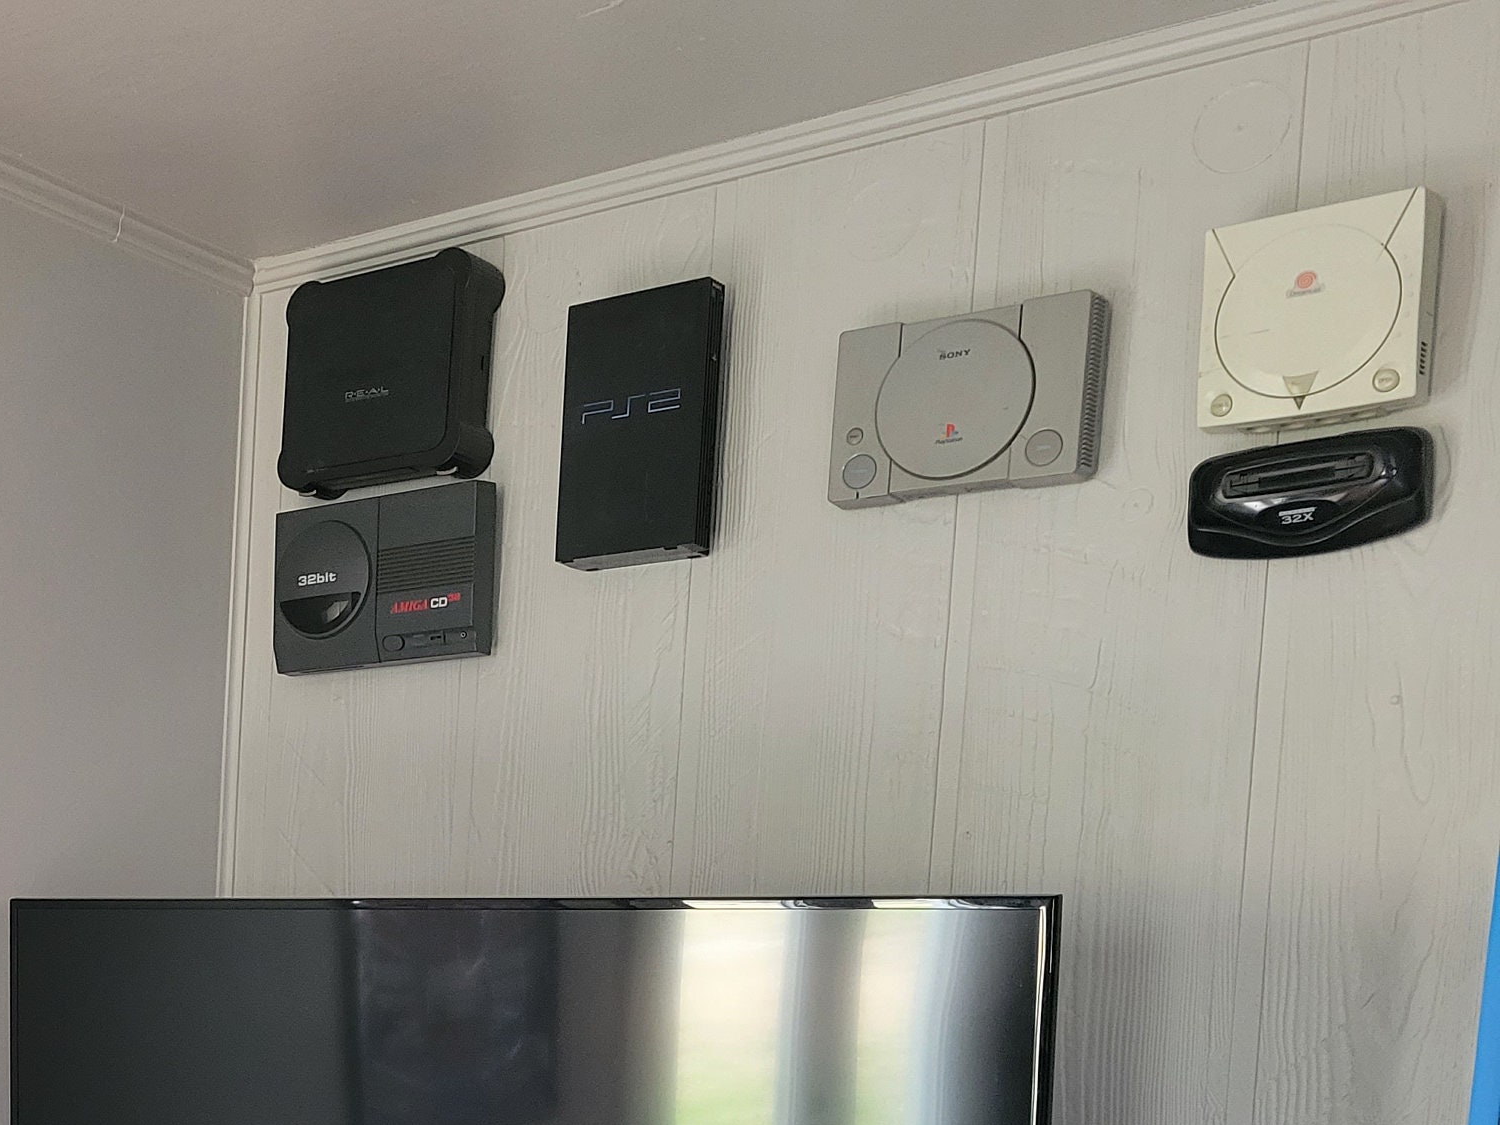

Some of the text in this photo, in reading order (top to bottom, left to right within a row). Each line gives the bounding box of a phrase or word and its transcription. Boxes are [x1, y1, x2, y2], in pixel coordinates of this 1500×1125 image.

[939, 348, 971, 361] SONY
[582, 388, 681, 425] PS2
[1280, 511, 1315, 525] 32X
[297, 572, 337, 587] 32bit
[389, 599, 428, 614] AMIGA
